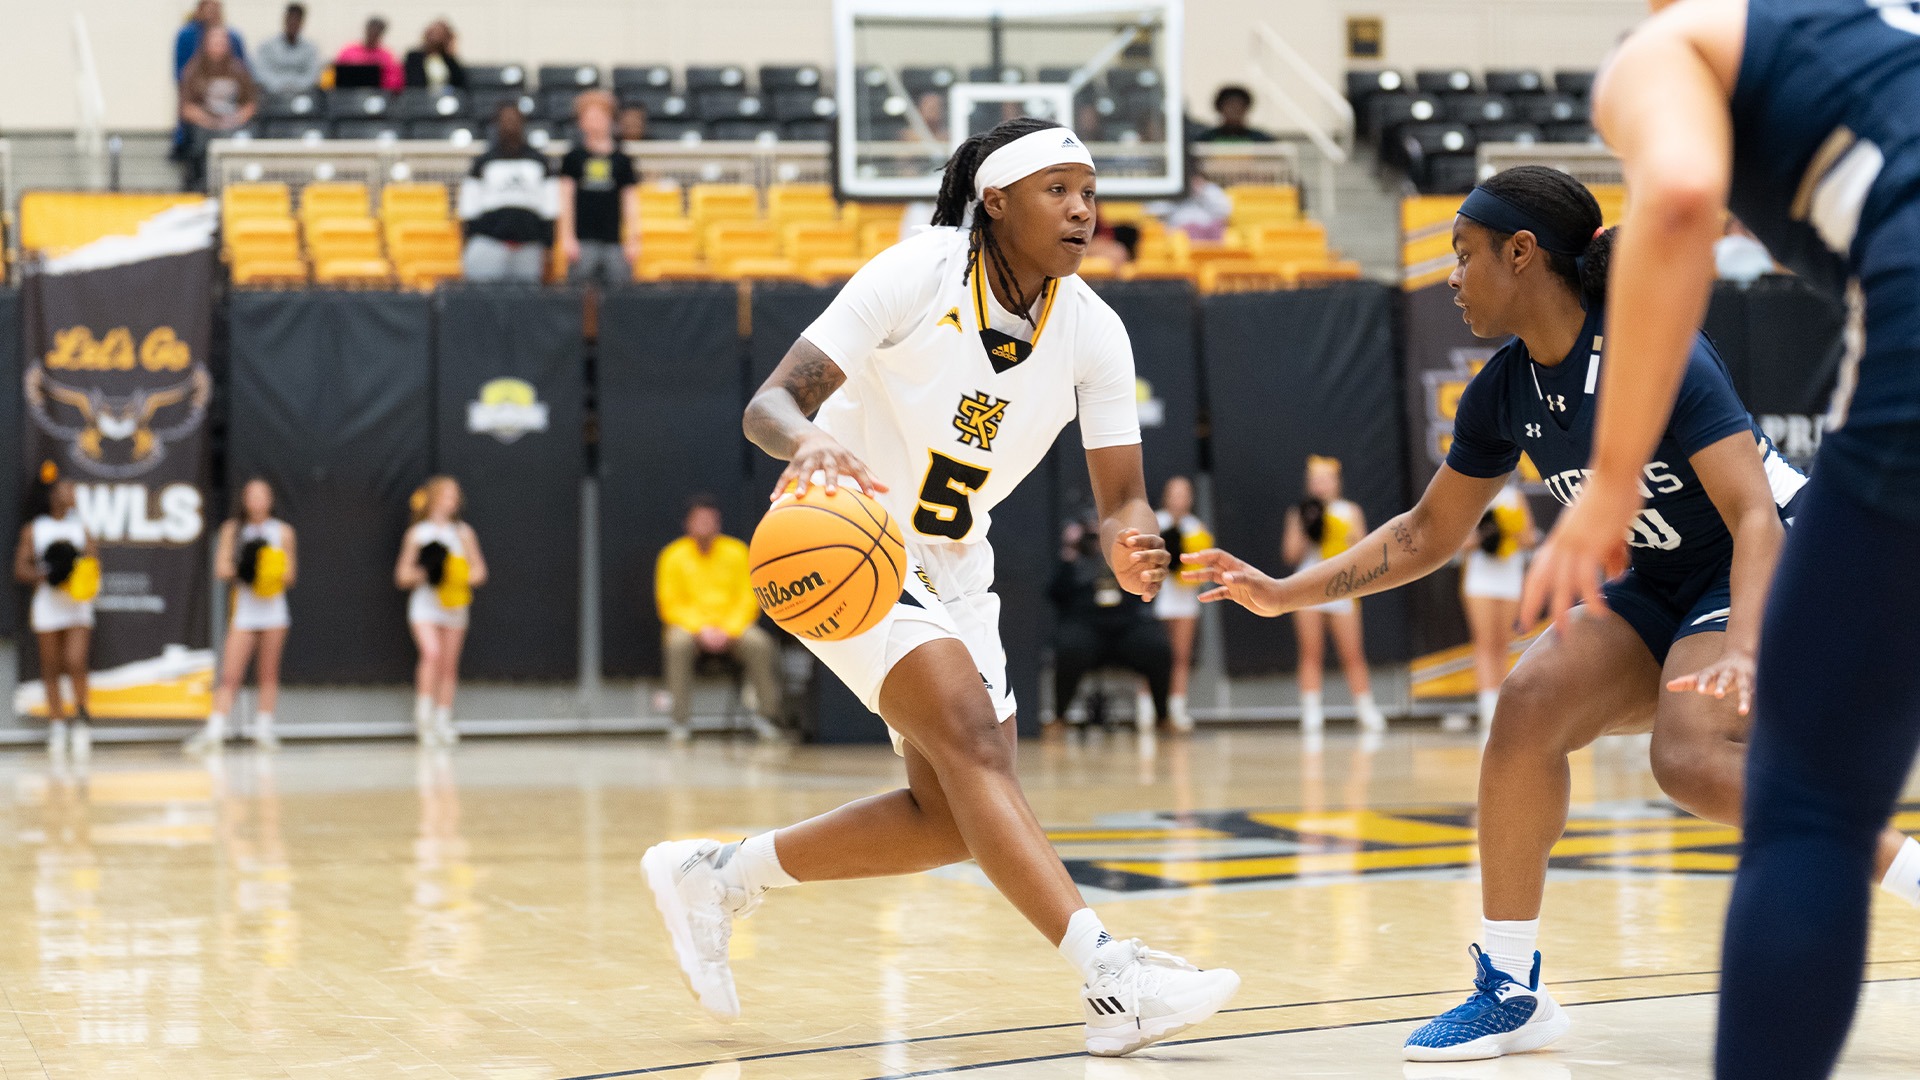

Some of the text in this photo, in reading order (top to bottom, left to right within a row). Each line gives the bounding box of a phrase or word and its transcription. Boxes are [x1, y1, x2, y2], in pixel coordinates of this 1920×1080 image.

[991, 348, 1018, 363] adidas
[74, 483, 202, 542] WLS
[911, 447, 992, 542] 5
[1623, 508, 1682, 551] 0
[752, 571, 826, 611] Wilson
[1324, 542, 1390, 598] Blessed
